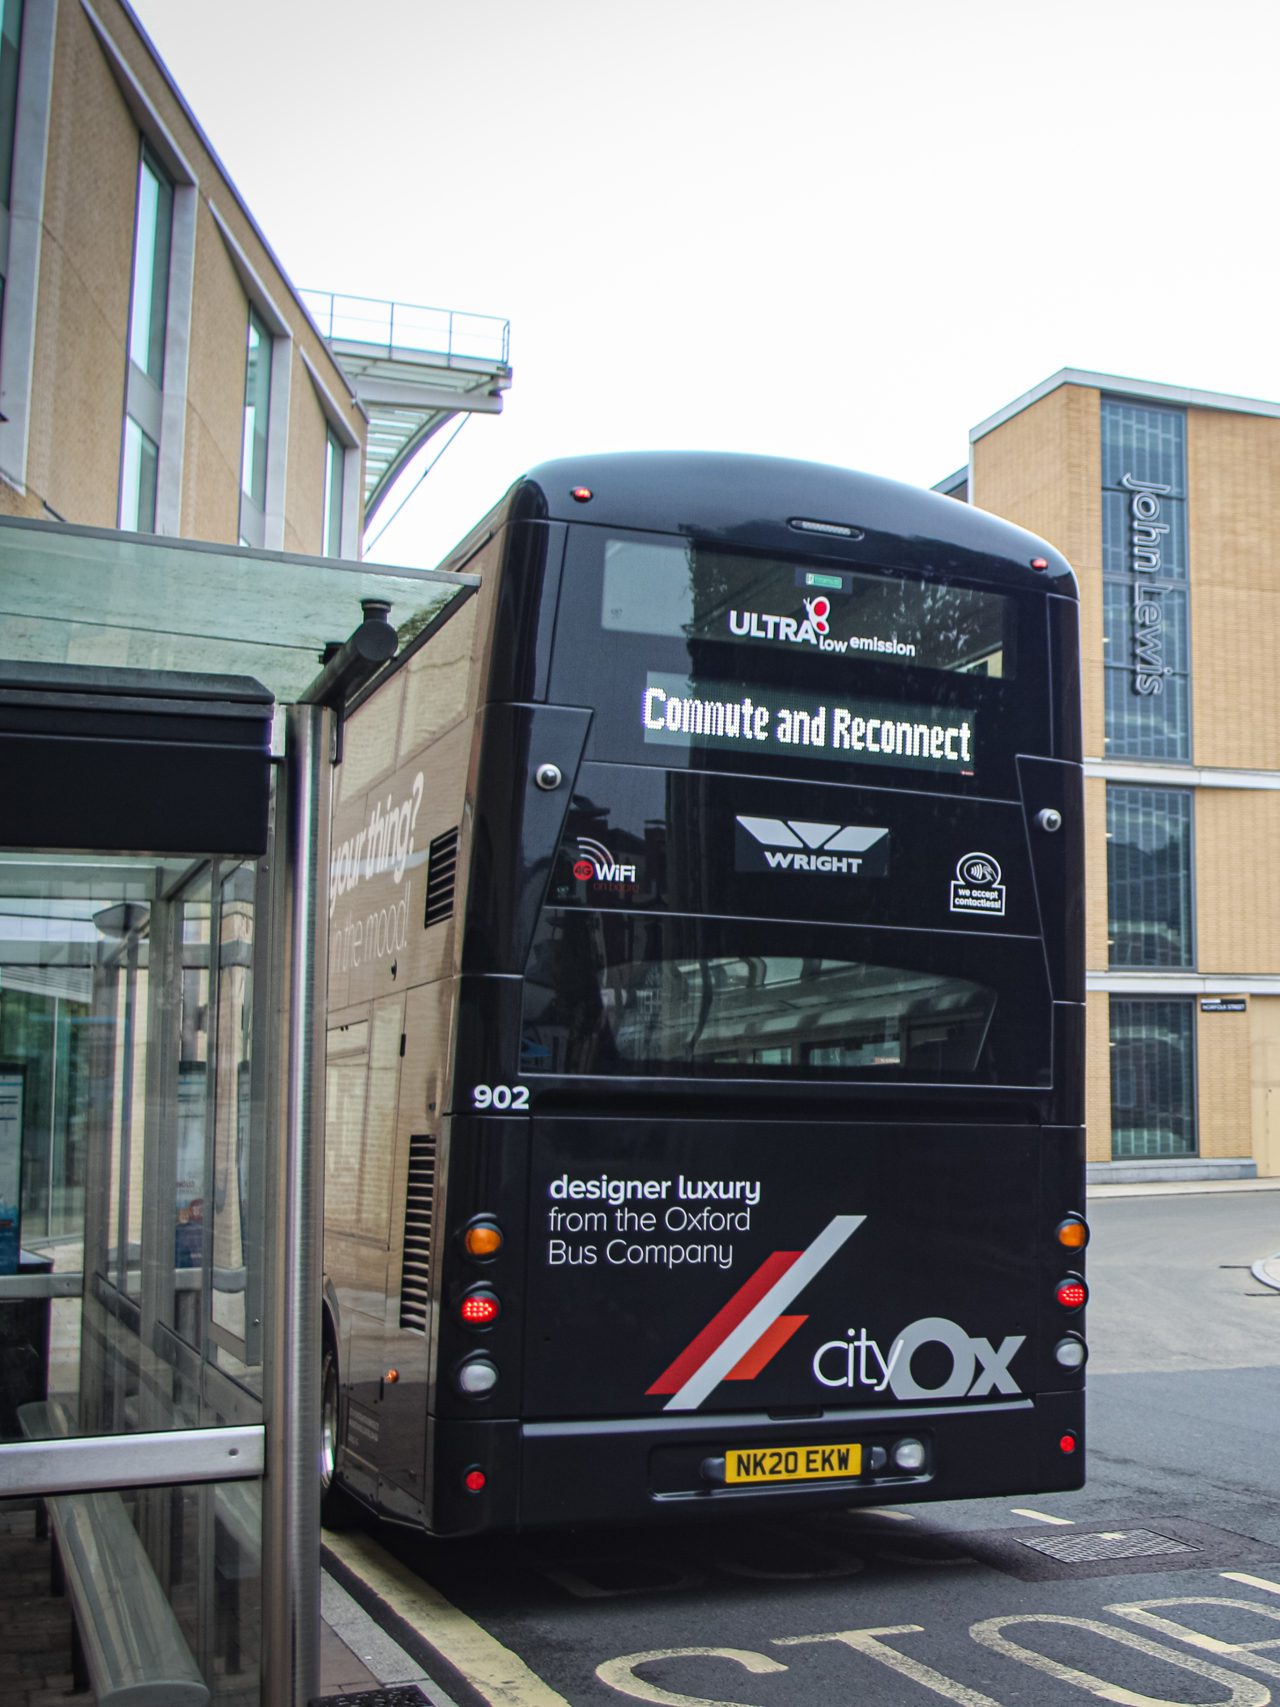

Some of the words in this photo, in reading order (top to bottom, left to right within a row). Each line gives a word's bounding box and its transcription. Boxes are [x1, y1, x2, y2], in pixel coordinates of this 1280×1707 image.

[1122, 473, 1171, 574] John
[729, 610, 817, 645] ULTRA
[819, 634, 847, 653] low
[850, 636, 915, 657] emission
[1134, 581, 1173, 696] Lewis
[643, 687, 768, 742] Commute
[776, 707, 826, 747] and
[832, 708, 971, 762] Reconnect
[366, 772, 423, 884] thing?
[764, 851, 863, 874] WRIGHT
[955, 898, 1001, 909] contactless!
[958, 888, 970, 897] we
[972, 890, 999, 900] accept
[473, 1085, 530, 1110] 902
[549, 1174, 671, 1205] designer
[679, 1176, 761, 1205] luxury
[548, 1207, 608, 1232] from
[616, 1207, 657, 1232] the
[665, 1207, 751, 1232] Oxford
[548, 1240, 598, 1266] Bus
[606, 1240, 734, 1270] Company
[735, 1452, 798, 1477] NK20
[805, 1449, 851, 1474] EKW
